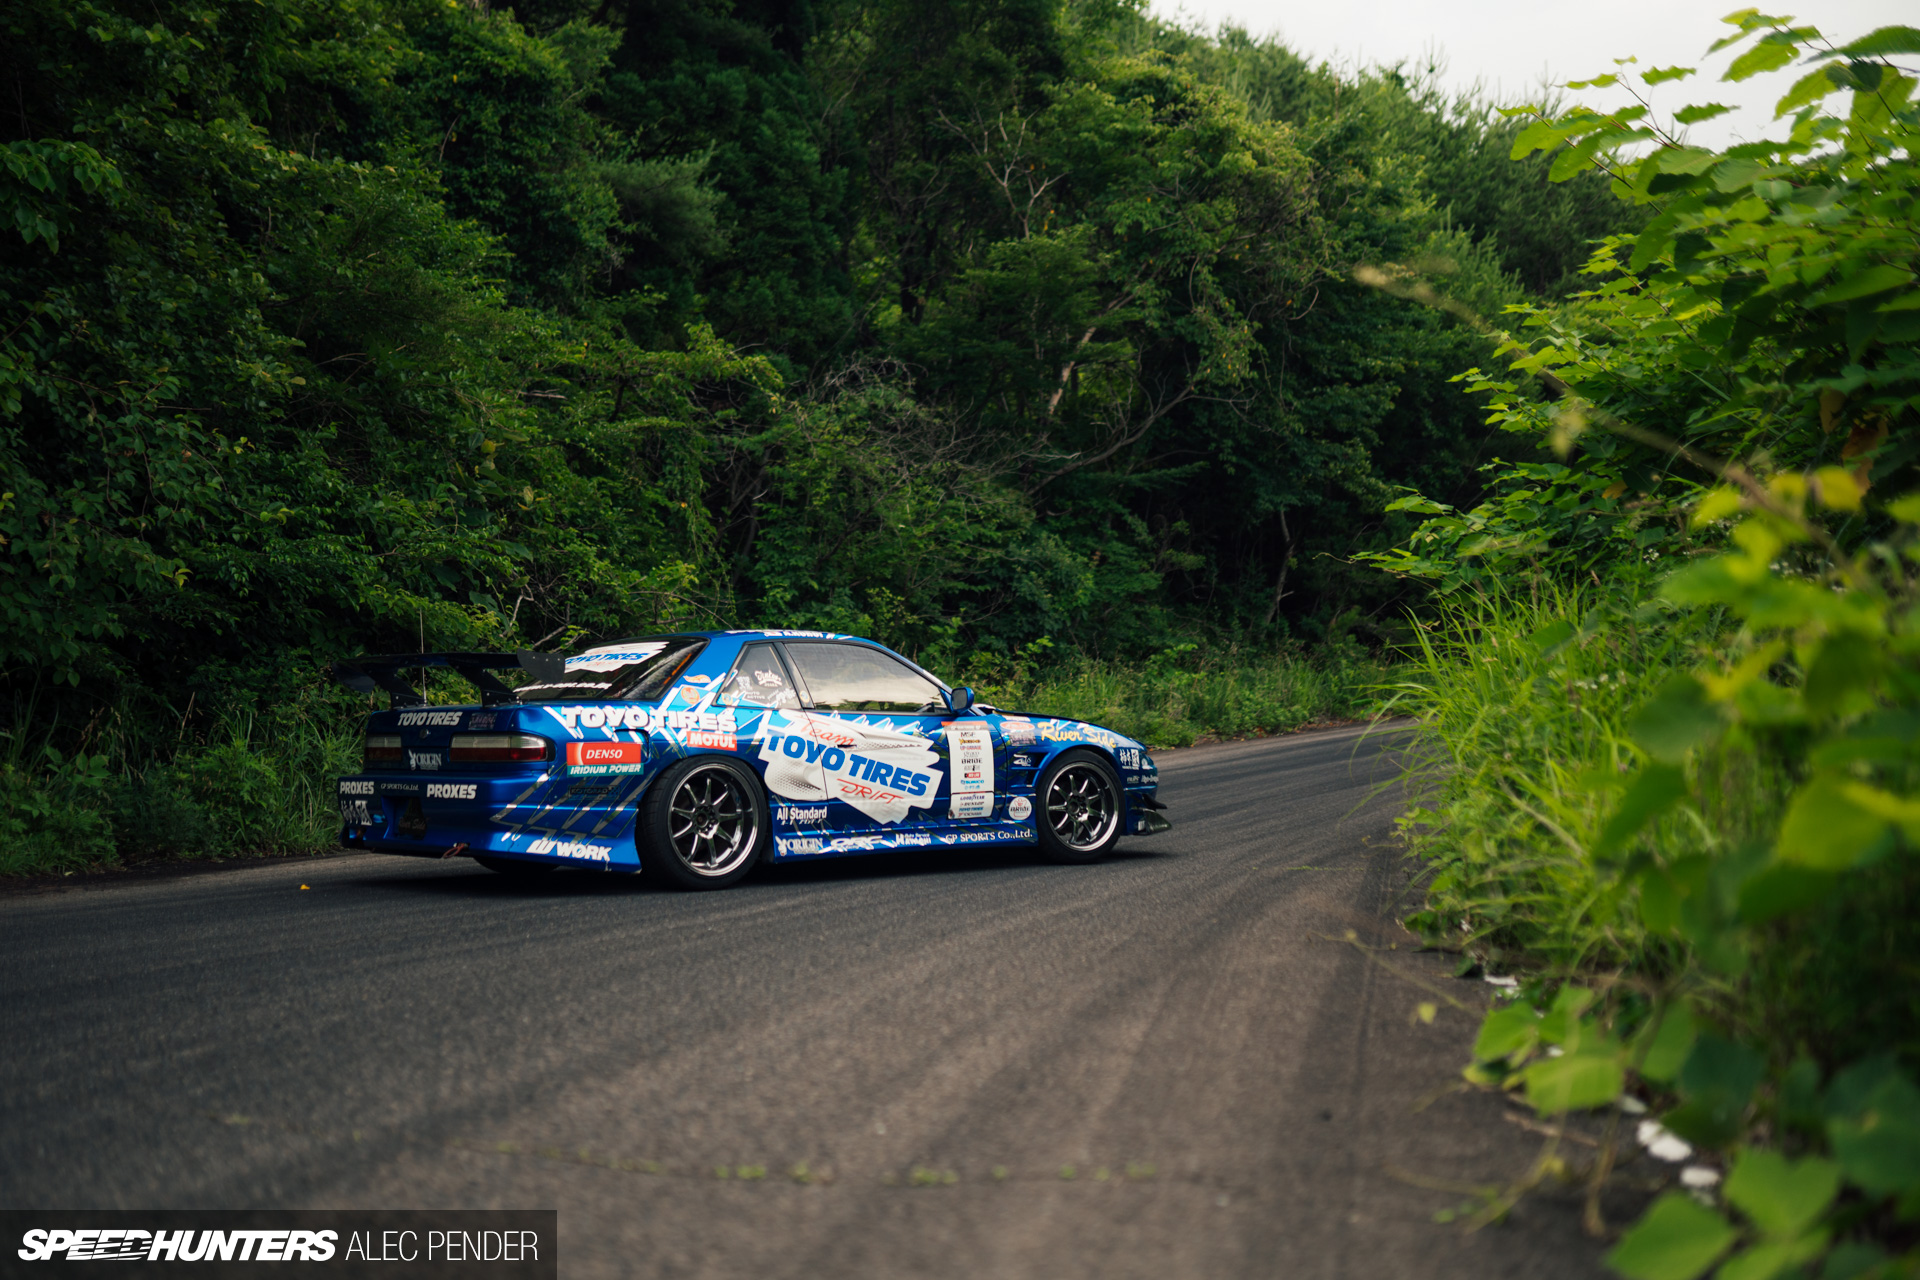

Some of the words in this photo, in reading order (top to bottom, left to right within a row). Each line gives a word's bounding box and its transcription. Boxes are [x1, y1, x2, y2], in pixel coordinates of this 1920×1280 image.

[398, 712, 428, 726] TOYO
[426, 712, 463, 726] TIRES
[561, 706, 649, 729] TOYO
[649, 710, 738, 732] TIRES
[798, 715, 854, 746] Team
[1037, 721, 1083, 742] River
[1083, 727, 1117, 748] Side
[689, 733, 736, 748] MOTUL
[416, 753, 442, 766] ORIGIN
[586, 749, 623, 759] DENSO
[570, 766, 607, 775] IRIDIUM
[608, 764, 641, 773] POWER
[767, 730, 846, 771] TOYO
[848, 753, 931, 797] TIRES
[340, 781, 375, 794] PROXES
[426, 784, 477, 799] PROXES
[836, 778, 904, 804] DRIFT
[776, 807, 789, 820] All
[790, 806, 828, 819] Standard
[787, 838, 824, 850] ORIGIN
[960, 832, 996, 842] SPORTS
[556, 841, 612, 861] WORK
